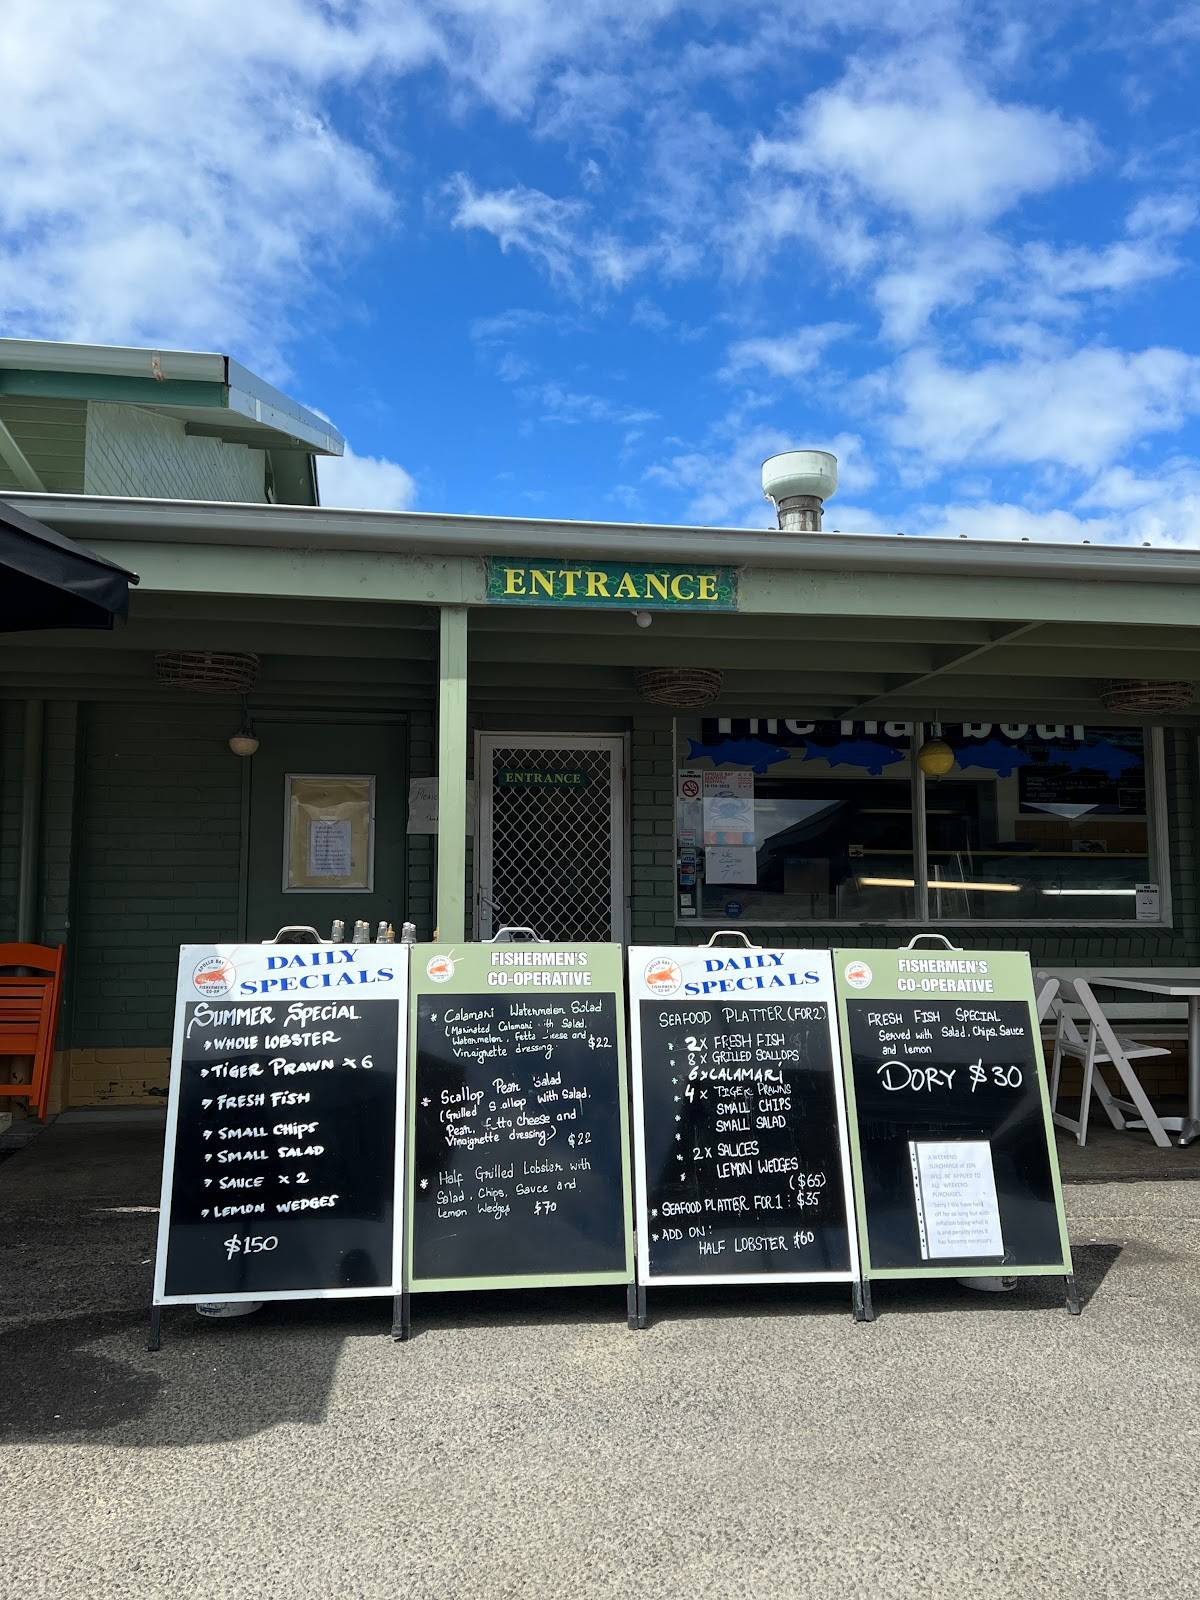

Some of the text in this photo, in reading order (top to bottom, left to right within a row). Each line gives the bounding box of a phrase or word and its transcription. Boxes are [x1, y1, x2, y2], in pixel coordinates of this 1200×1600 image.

[504, 568, 719, 601] ENTRANCE
[505, 772, 582, 785] ENTRANCE
[198, 960, 214, 972] APOLLO
[266, 949, 359, 970] DAILY
[491, 951, 588, 966] FISHERMEN'S
[705, 952, 785, 972] DAILY
[898, 960, 988, 974] FISHERMEN'S
[240, 968, 394, 996] SPECIALS
[487, 972, 592, 986] CO-OPERATIVE
[684, 970, 820, 996] SPECIALS
[897, 978, 994, 993] CO-OPERATIVE
[186, 1002, 275, 1038] SUMMER
[444, 999, 602, 1024] Calamari Watermelon Salad
[658, 1011, 712, 1028] SEAFOOD
[722, 1006, 786, 1024] PLATTER
[868, 1008, 1002, 1026] FRESH FISH SPECIAL
[498, 1021, 533, 1032] Calamari
[572, 1030, 586, 1040] and
[878, 1029, 911, 1041] Served
[916, 1030, 933, 1040] with
[1000, 1024, 1024, 1036] Sauce
[214, 1030, 342, 1050] WHOLE LOBSTER
[588, 1034, 612, 1050] $22
[714, 1034, 752, 1048] FRESH
[756, 1033, 785, 1046] FISH
[712, 1049, 752, 1063] GRILLED
[756, 1049, 800, 1061] SCALLOPS
[882, 1044, 932, 1056] and lemon
[268, 1057, 334, 1077] PRAWN
[361, 1055, 374, 1069] 6
[876, 1058, 1022, 1093] DORY $30
[440, 1071, 562, 1105] Scallop Pear Salad
[684, 1086, 694, 1103] 4
[714, 1086, 754, 1098] TIGER
[758, 1082, 792, 1095] PRAWNS
[216, 1092, 266, 1110] FRESH
[440, 1108, 478, 1122] (Grilled
[488, 1098, 526, 1112] Sallop
[537, 1090, 558, 1104] with
[716, 1098, 792, 1115] SMALL CHIPS
[516, 1110, 550, 1126] cheese
[556, 1108, 576, 1122] and
[715, 1116, 786, 1132] SMALL SALAD
[218, 1127, 268, 1140] SMALL
[568, 1132, 592, 1148] $22
[217, 1146, 324, 1164] SMALL SALAD
[718, 1140, 760, 1158] SAUCES
[438, 1158, 592, 1187] Half Grilled Lobster with
[716, 1157, 799, 1179] LEMON WEDGES
[219, 1176, 264, 1190] SAUCE
[296, 1172, 310, 1184] 2
[516, 1184, 549, 1196] Sauce
[556, 1178, 576, 1190] and
[214, 1194, 340, 1218] LEMON WEDGES
[438, 1204, 511, 1219] Lemon Wedges
[534, 1200, 557, 1216] $70
[662, 1200, 702, 1217] SEAFOOD
[705, 1196, 750, 1212] PLATTER
[796, 1190, 820, 1210] $35
[662, 1228, 682, 1241] ADD
[224, 1234, 278, 1260] $150
[699, 1240, 726, 1256] HALF
[734, 1236, 788, 1252] LOBSTER
